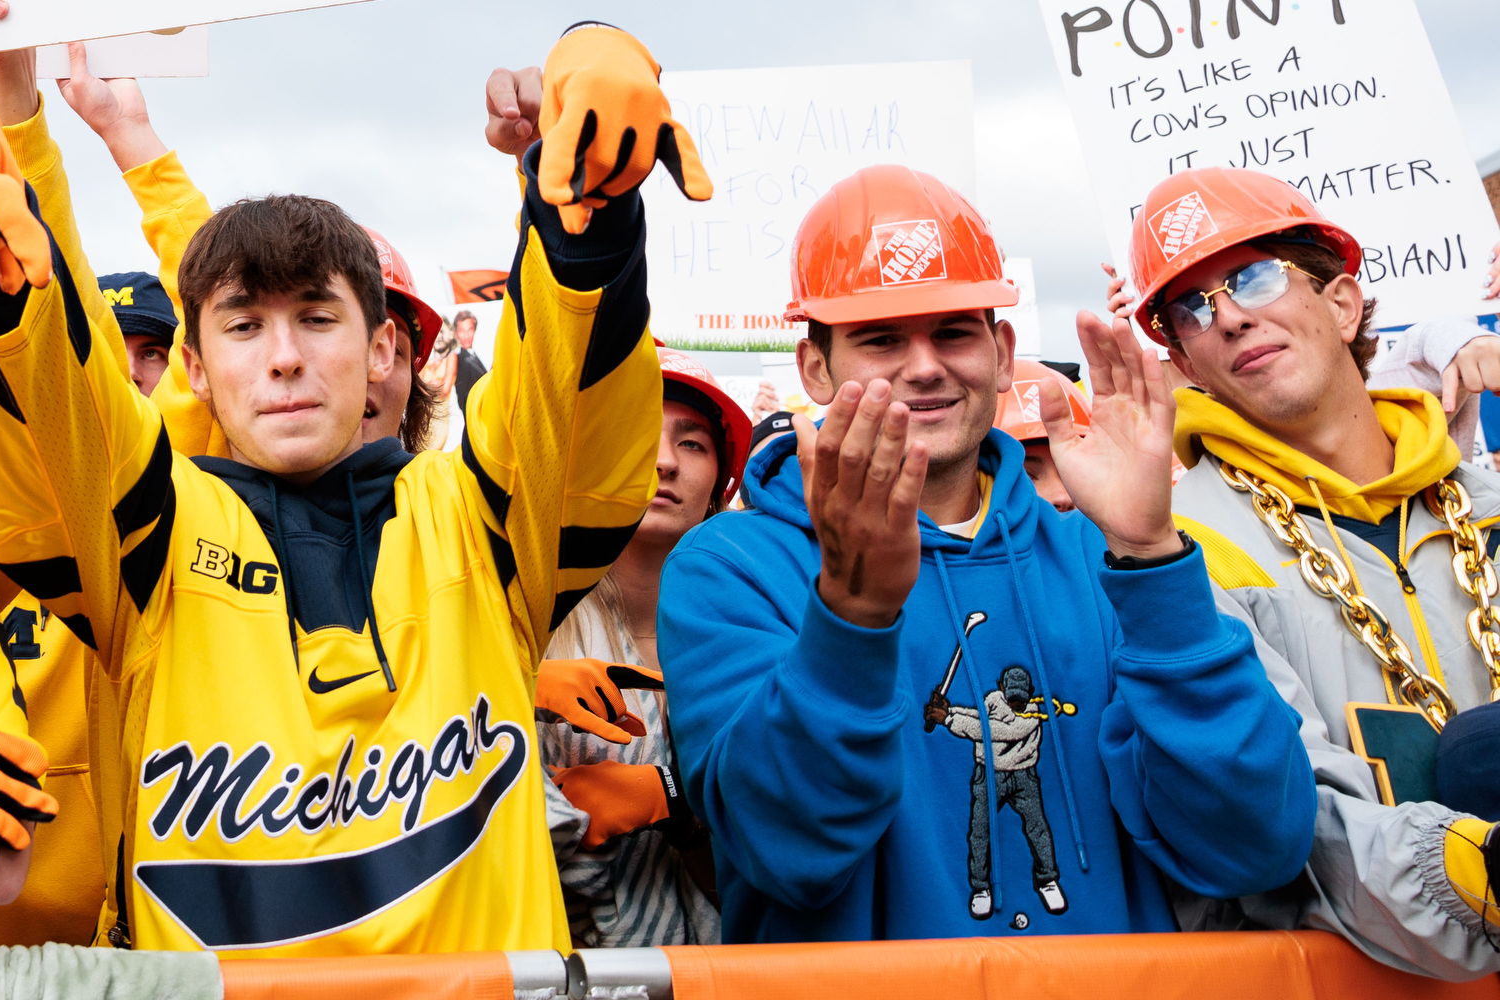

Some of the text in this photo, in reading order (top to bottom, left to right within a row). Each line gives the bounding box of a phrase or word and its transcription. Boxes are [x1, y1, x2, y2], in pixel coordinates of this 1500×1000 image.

[1110, 46, 1301, 109] IT'S LIKE A
[1130, 77, 1386, 143] COW'S OPINION.
[1228, 127, 1315, 169] JUST
[723, 164, 820, 206] FOR
[883, 228, 908, 253] THE
[1158, 210, 1175, 234] THE
[1163, 196, 1201, 254] HOME
[1182, 206, 1206, 245] DEPOT
[671, 220, 731, 278] HE
[882, 221, 938, 283] HOME
[906, 240, 941, 280] DEPOT
[103, 286, 134, 307] M
[695, 314, 736, 330] THE
[140, 692, 496, 836] Michigan
